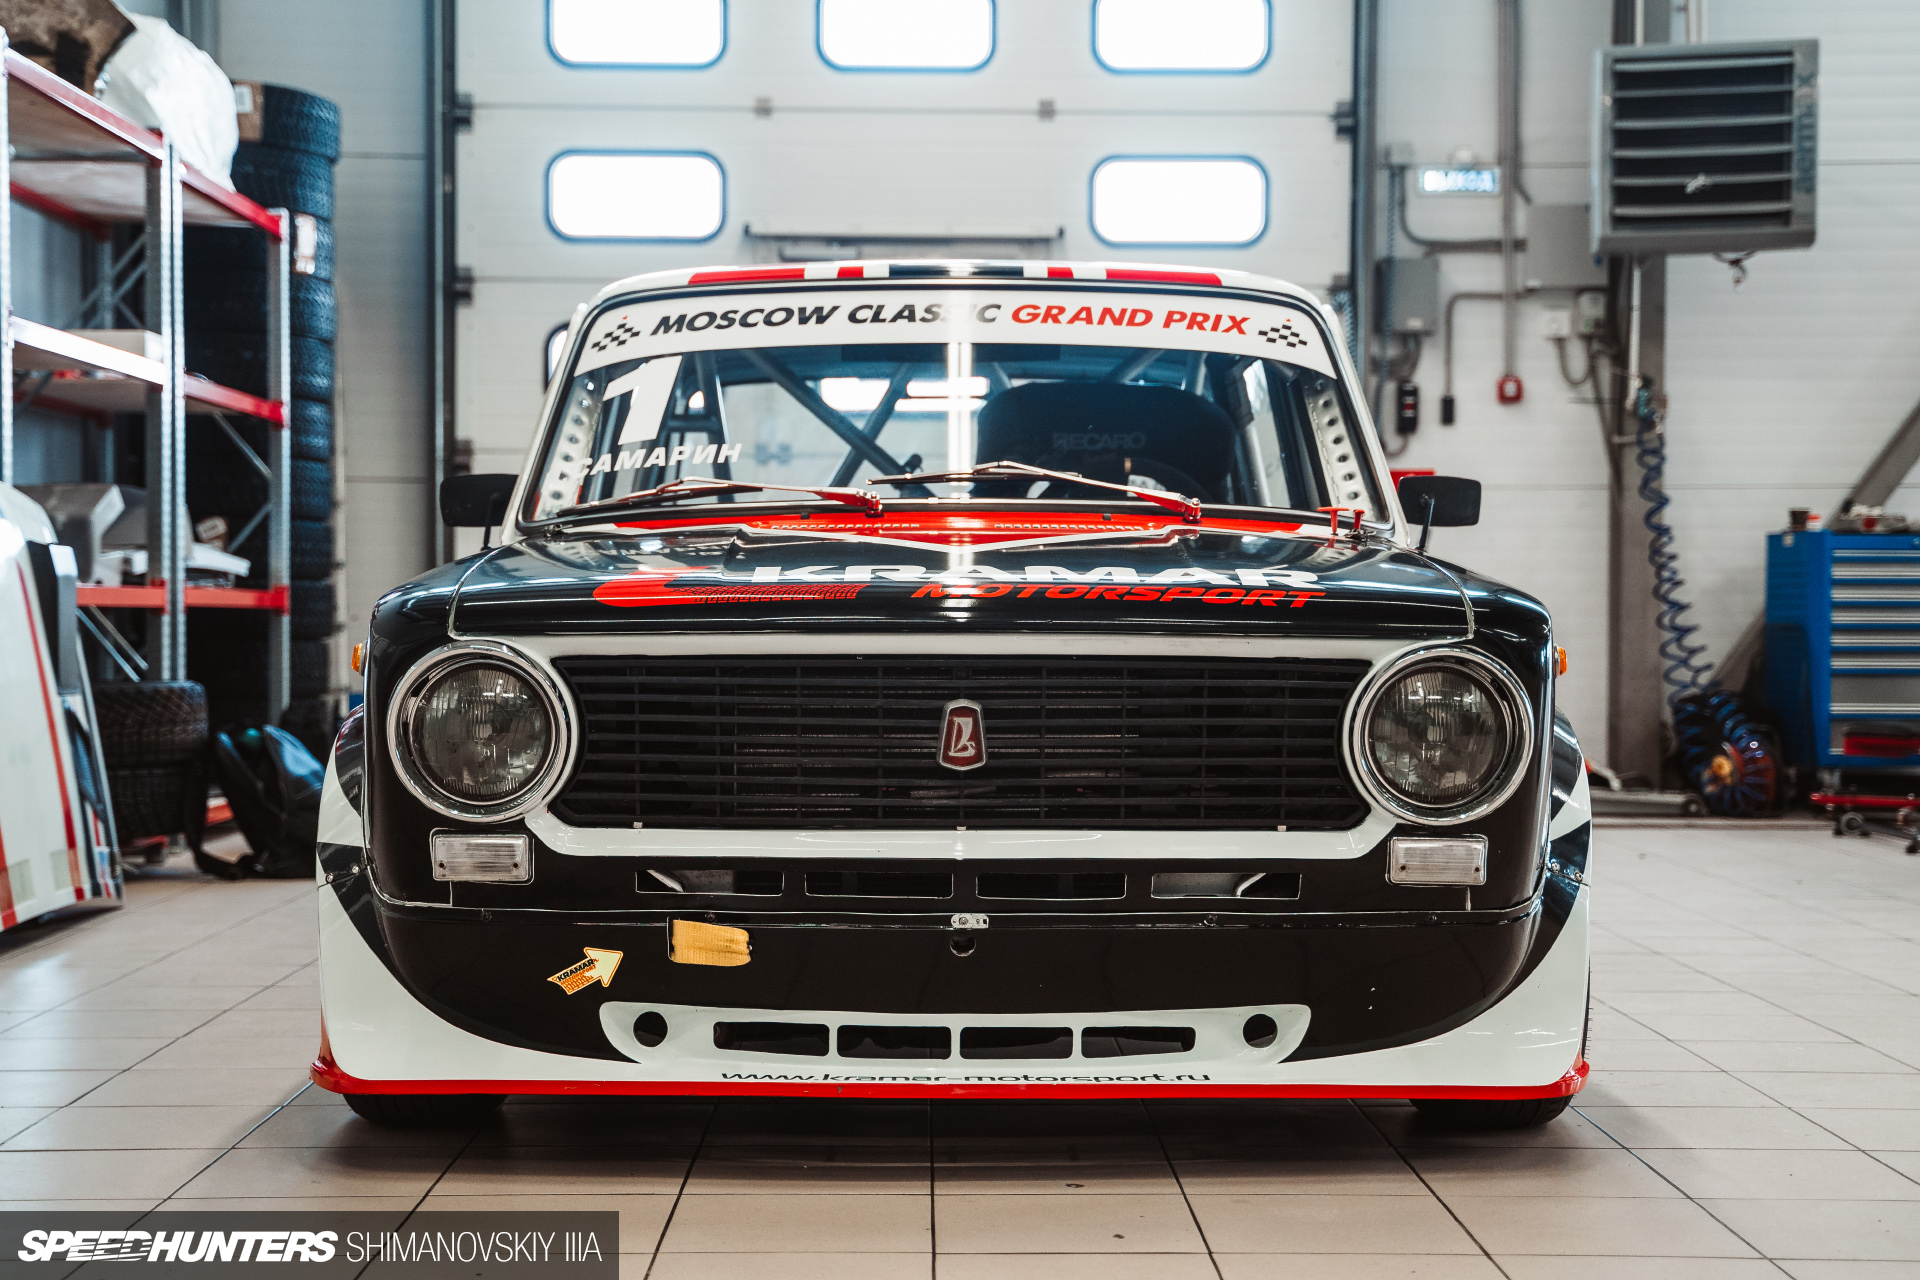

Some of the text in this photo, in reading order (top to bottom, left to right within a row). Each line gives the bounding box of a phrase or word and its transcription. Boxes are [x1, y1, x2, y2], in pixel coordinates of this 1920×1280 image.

[650, 303, 1251, 336] MOSCOW CLASC GRAND PRIX
[603, 355, 682, 445] 1
[1053, 431, 1145, 449] RECARO
[577, 443, 742, 478] САМАРИН
[751, 565, 1326, 589] KRAMAR
[911, 583, 1326, 608] MOTORSPORT
[557, 958, 594, 981] KRAMAR
[722, 1073, 1211, 1082] www.kramar-motorsport.ru
